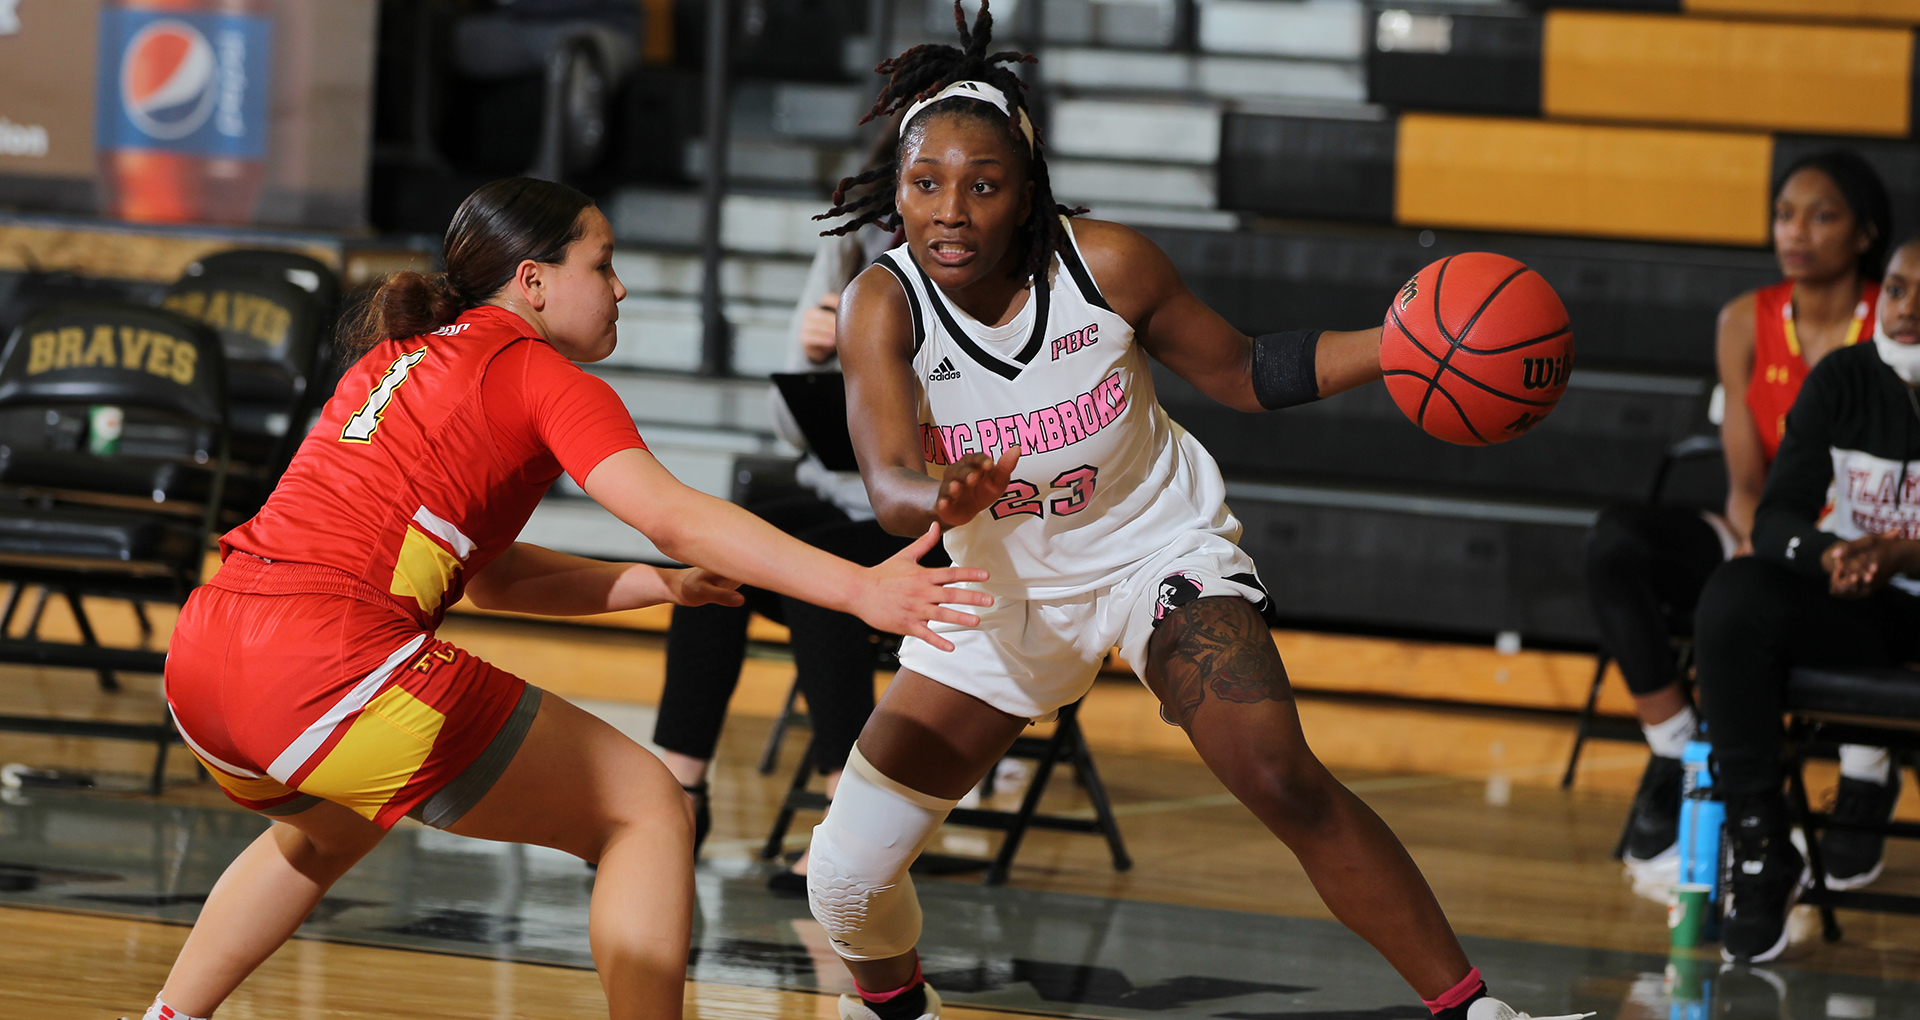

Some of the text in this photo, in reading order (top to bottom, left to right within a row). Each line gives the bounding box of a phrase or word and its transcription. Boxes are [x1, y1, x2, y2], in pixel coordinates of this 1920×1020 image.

[27, 326, 198, 386] BRAVES
[1051, 323, 1099, 362] PBC
[338, 345, 429, 445] 1
[928, 370, 962, 382] adidas
[918, 371, 1128, 466] UNC PEMBROKE
[989, 464, 1099, 521] 23
